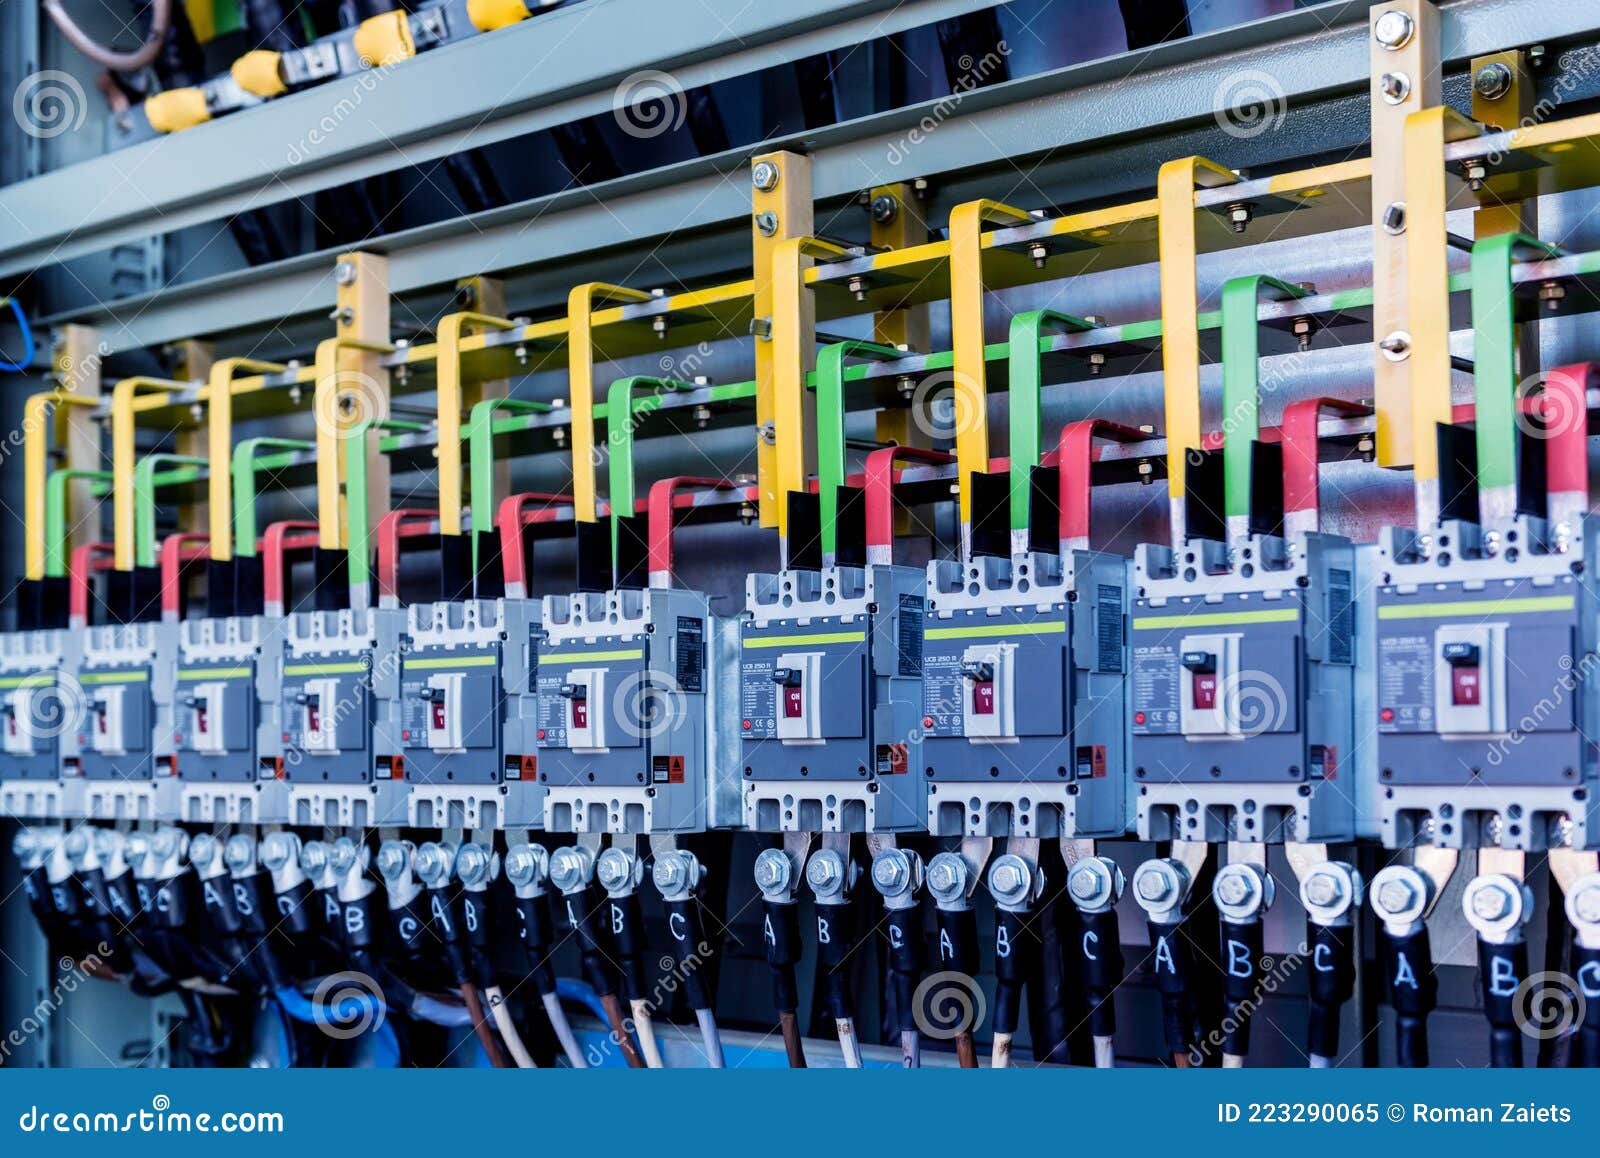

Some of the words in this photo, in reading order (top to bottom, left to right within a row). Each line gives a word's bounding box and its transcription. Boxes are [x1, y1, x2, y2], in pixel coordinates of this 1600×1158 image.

[108, 885, 132, 917] A
[203, 881, 224, 908] A
[233, 883, 253, 915] B
[324, 893, 341, 923] A
[345, 906, 364, 933] B
[431, 895, 450, 932] A
[465, 899, 478, 932] B
[611, 903, 625, 934] B
[669, 912, 686, 941] C
[763, 913, 776, 946] A
[817, 915, 831, 944] B
[939, 928, 954, 961] A
[996, 925, 1012, 958] B
[1082, 931, 1098, 960] C
[1154, 935, 1176, 974] A
[1227, 939, 1253, 978] B
[1314, 943, 1335, 973] C
[1393, 951, 1419, 990] A
[1489, 955, 1519, 995] B
